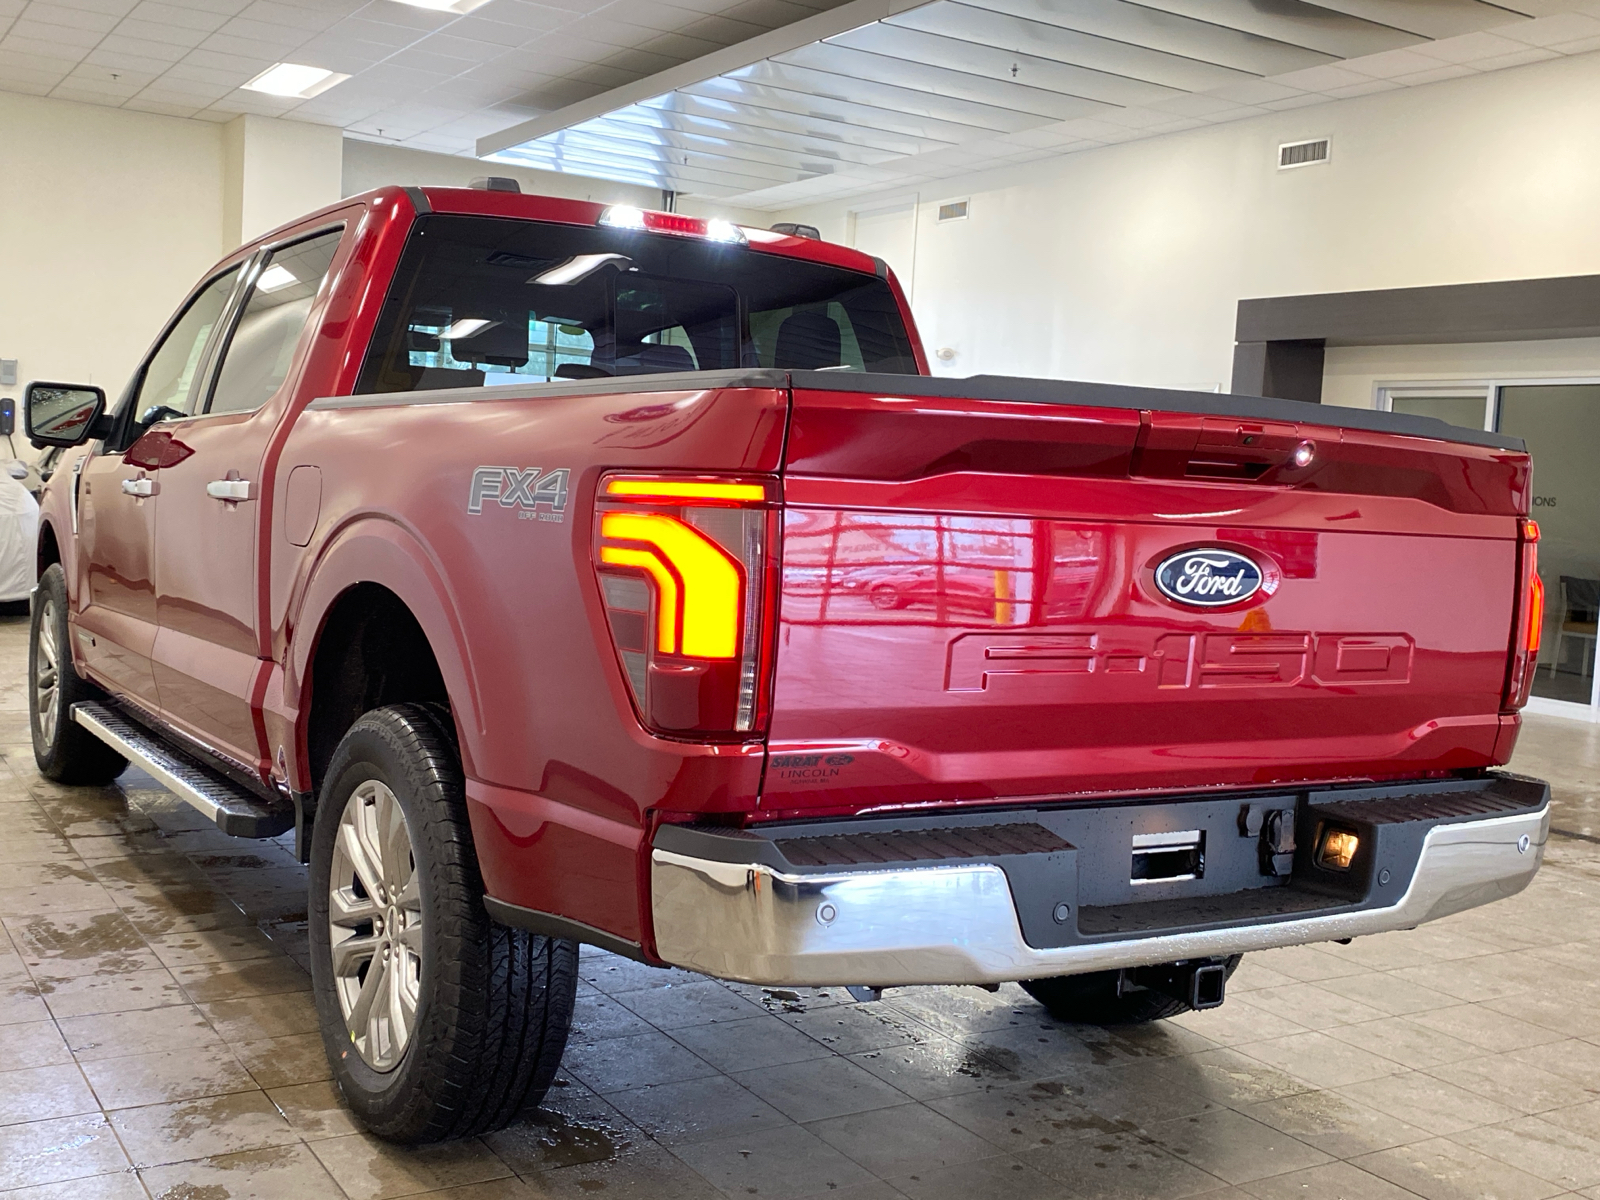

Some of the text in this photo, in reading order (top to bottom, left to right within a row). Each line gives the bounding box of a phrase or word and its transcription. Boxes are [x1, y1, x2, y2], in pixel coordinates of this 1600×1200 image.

[468, 466, 571, 515] FX4
[1176, 557, 1245, 595] Ford
[944, 631, 1416, 692] F-150
[770, 755, 822, 769] SARAT
[781, 768, 839, 778] LINCOLN
